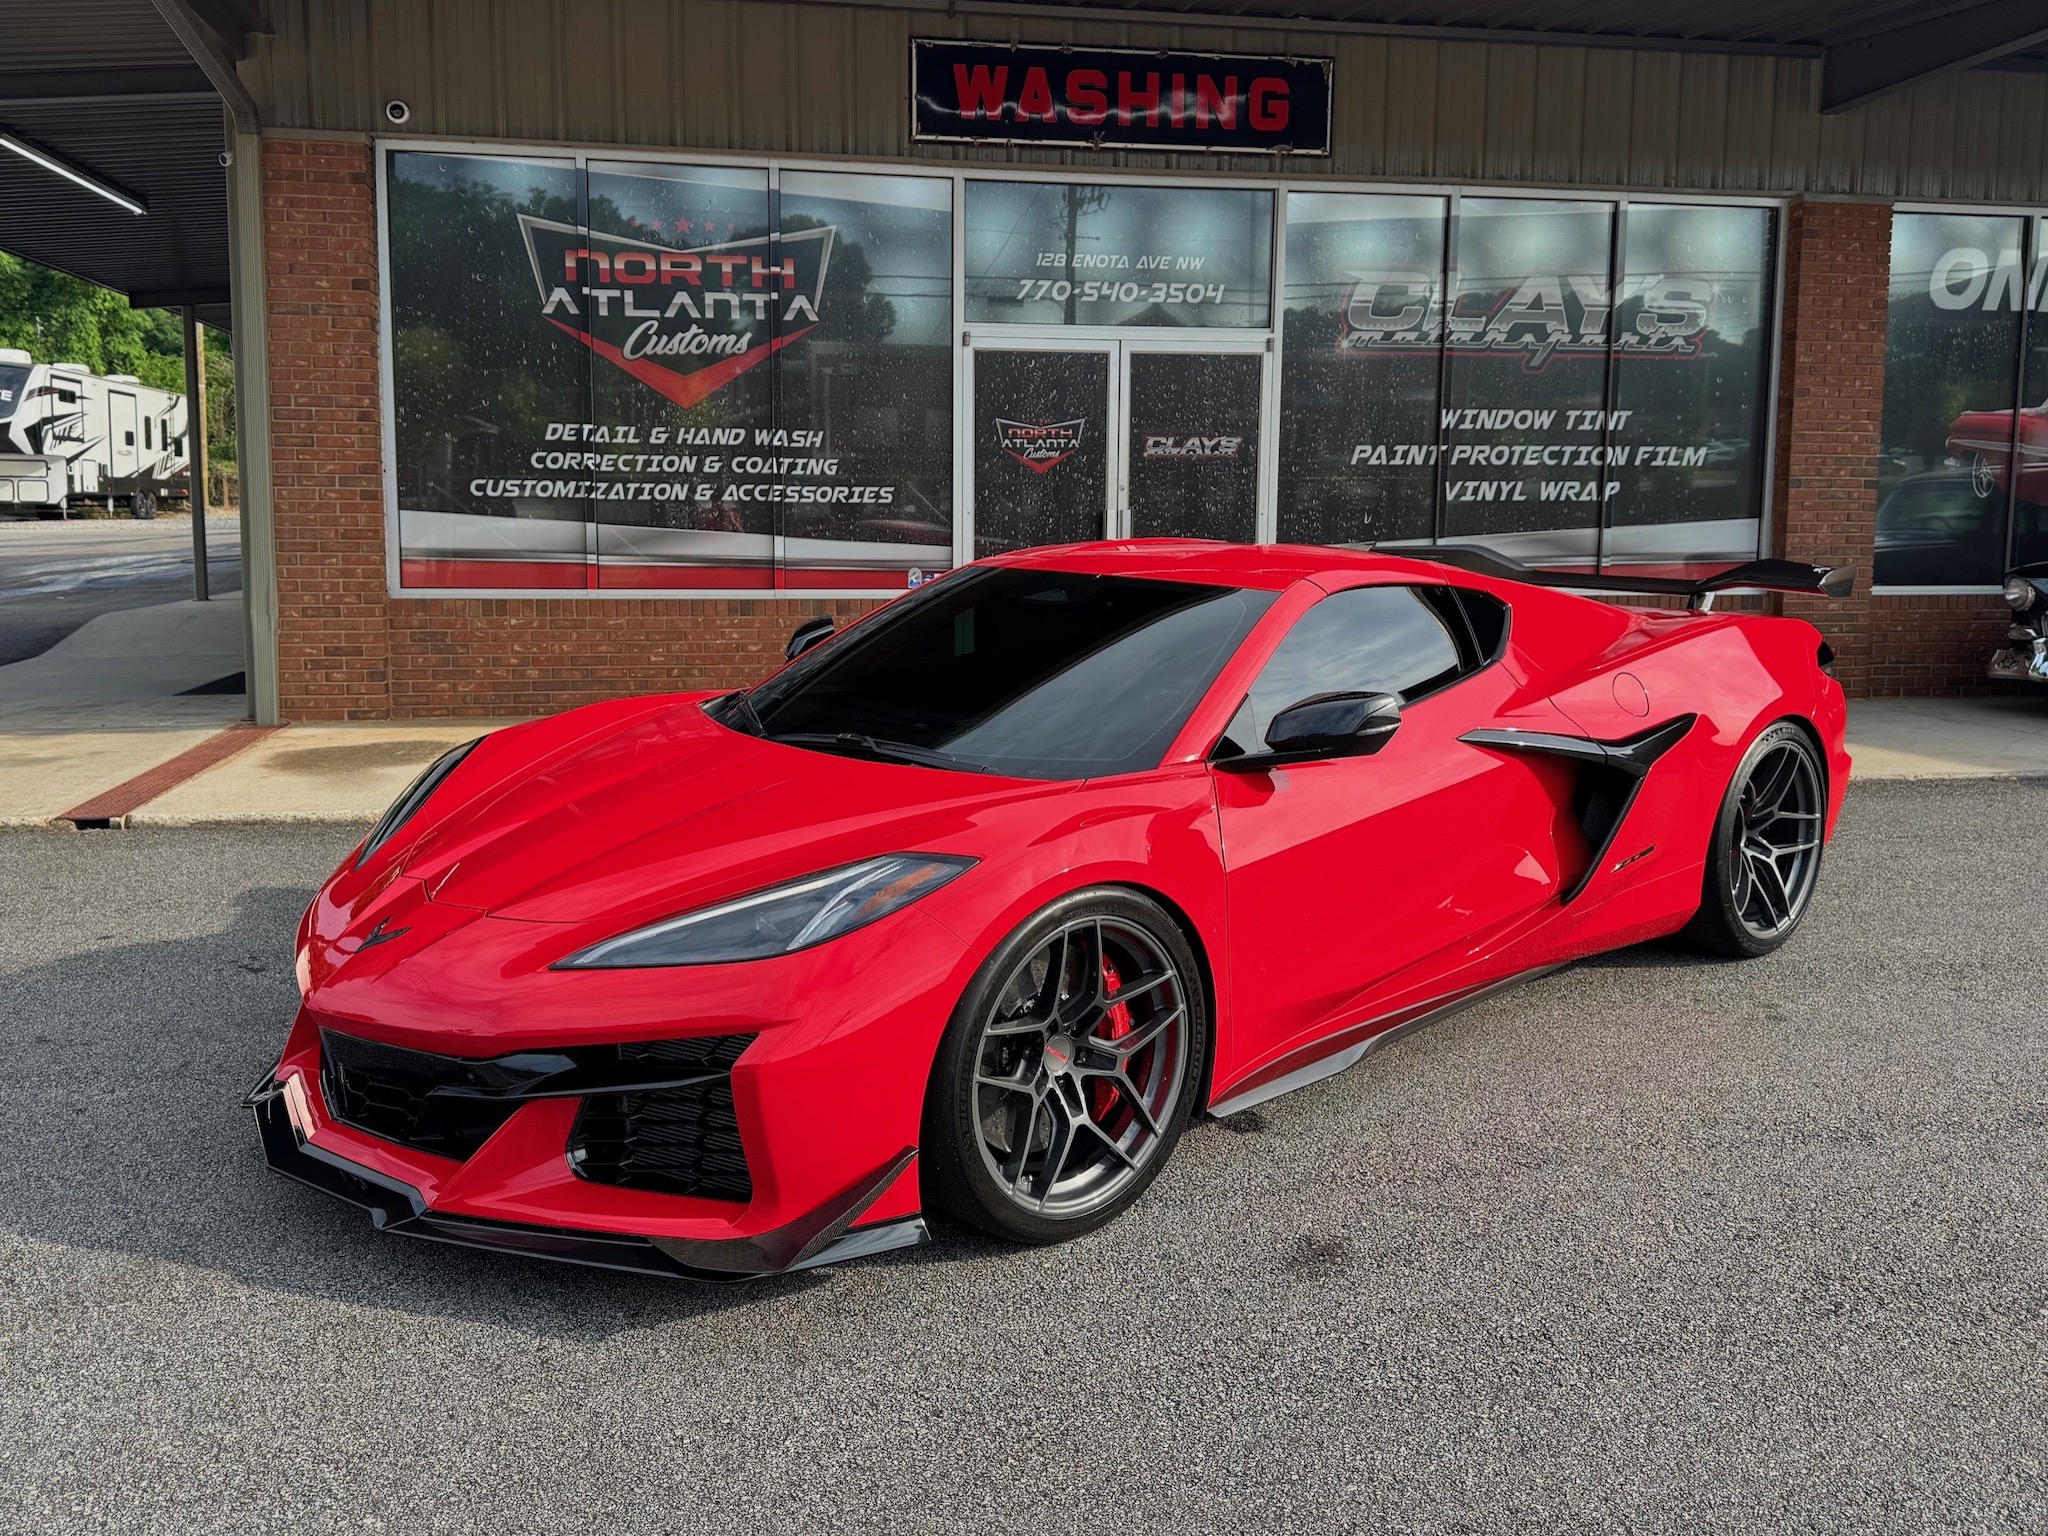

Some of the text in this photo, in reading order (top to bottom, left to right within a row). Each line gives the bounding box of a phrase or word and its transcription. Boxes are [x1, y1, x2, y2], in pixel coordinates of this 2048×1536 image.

[953, 63, 1290, 132] WASHING
[565, 248, 795, 288] NORTH
[1072, 254, 1129, 268] ENOTA
[1136, 256, 1172, 269] AVE
[1176, 256, 1205, 270] NW
[1018, 279, 1225, 304] 770-540-3504
[1929, 246, 2048, 313] ON
[541, 286, 819, 322] ATLANTA
[1342, 268, 1708, 338] CLAYS
[623, 319, 753, 360] Customs
[1441, 408, 1633, 431] WINDOW TINT
[545, 423, 824, 448] DETAIL & HAND WASH
[1001, 438, 1079, 448] ATLANTA
[1008, 428, 1072, 438] NORTH
[1145, 436, 1239, 453] CLAYS
[530, 451, 839, 476] CORRECTION & COATING
[1023, 447, 1060, 459] Customs
[1351, 444, 1708, 467] PAINT PROTECTION FILM
[469, 478, 895, 504] CUSTOMIZATION & ACCESSORIES
[1444, 480, 1621, 502] VINYL WRAP
